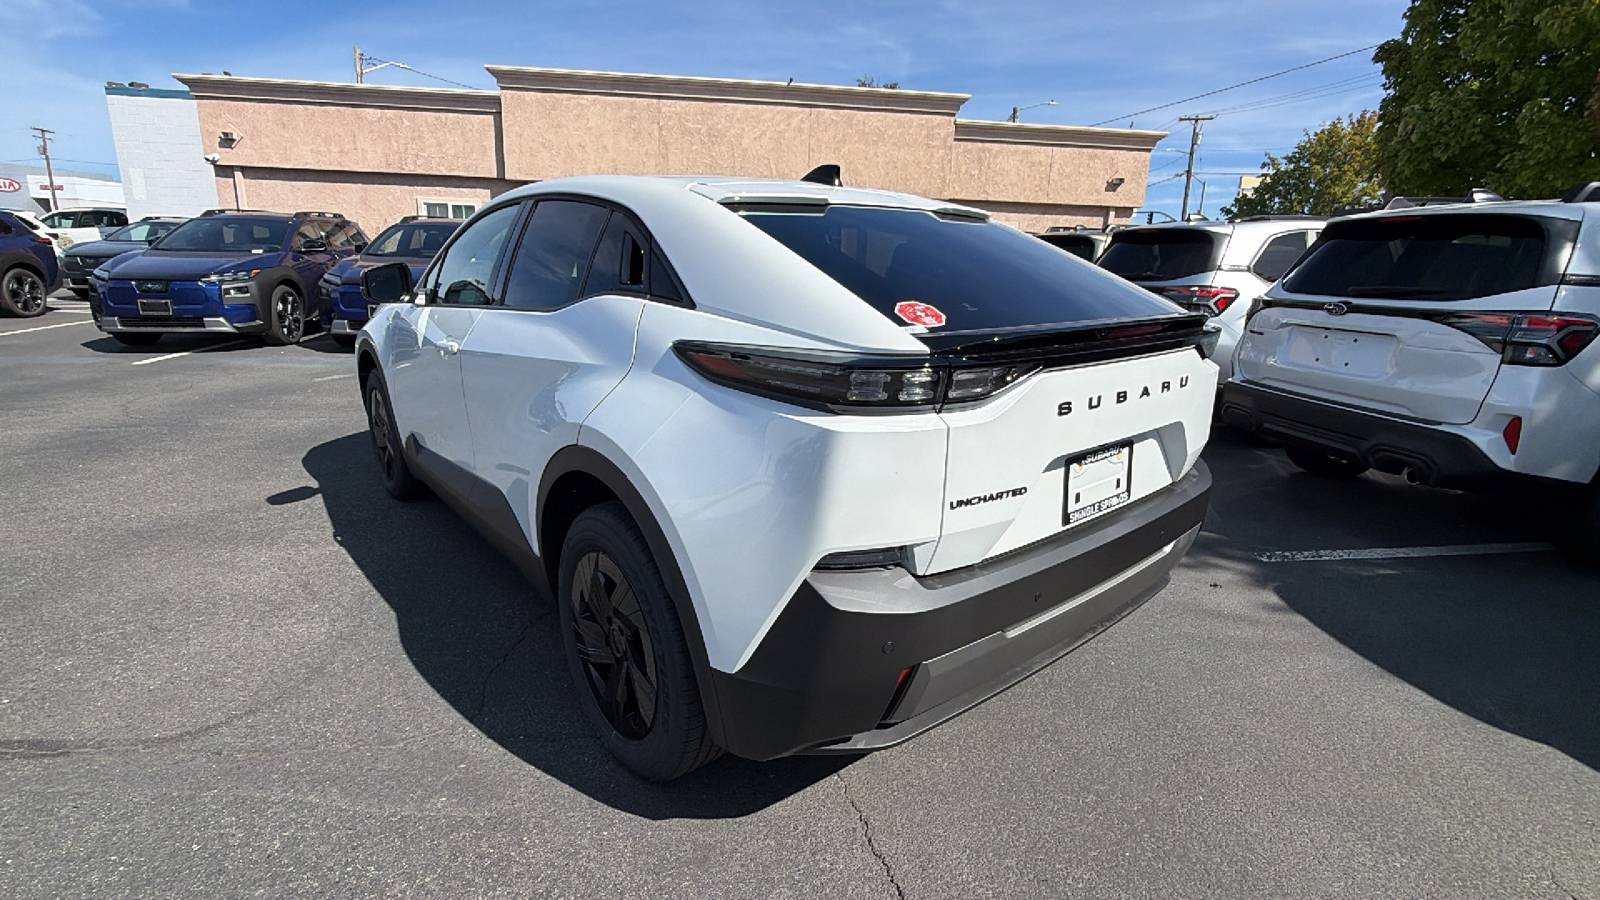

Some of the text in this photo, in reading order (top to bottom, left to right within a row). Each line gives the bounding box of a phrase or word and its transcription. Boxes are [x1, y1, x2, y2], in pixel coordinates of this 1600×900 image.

[1057, 375, 1189, 417] SUBARU
[1086, 445, 1120, 464] SUBARU
[949, 486, 1028, 511] UNCHARTED
[1069, 503, 1100, 523] SHINGLE
